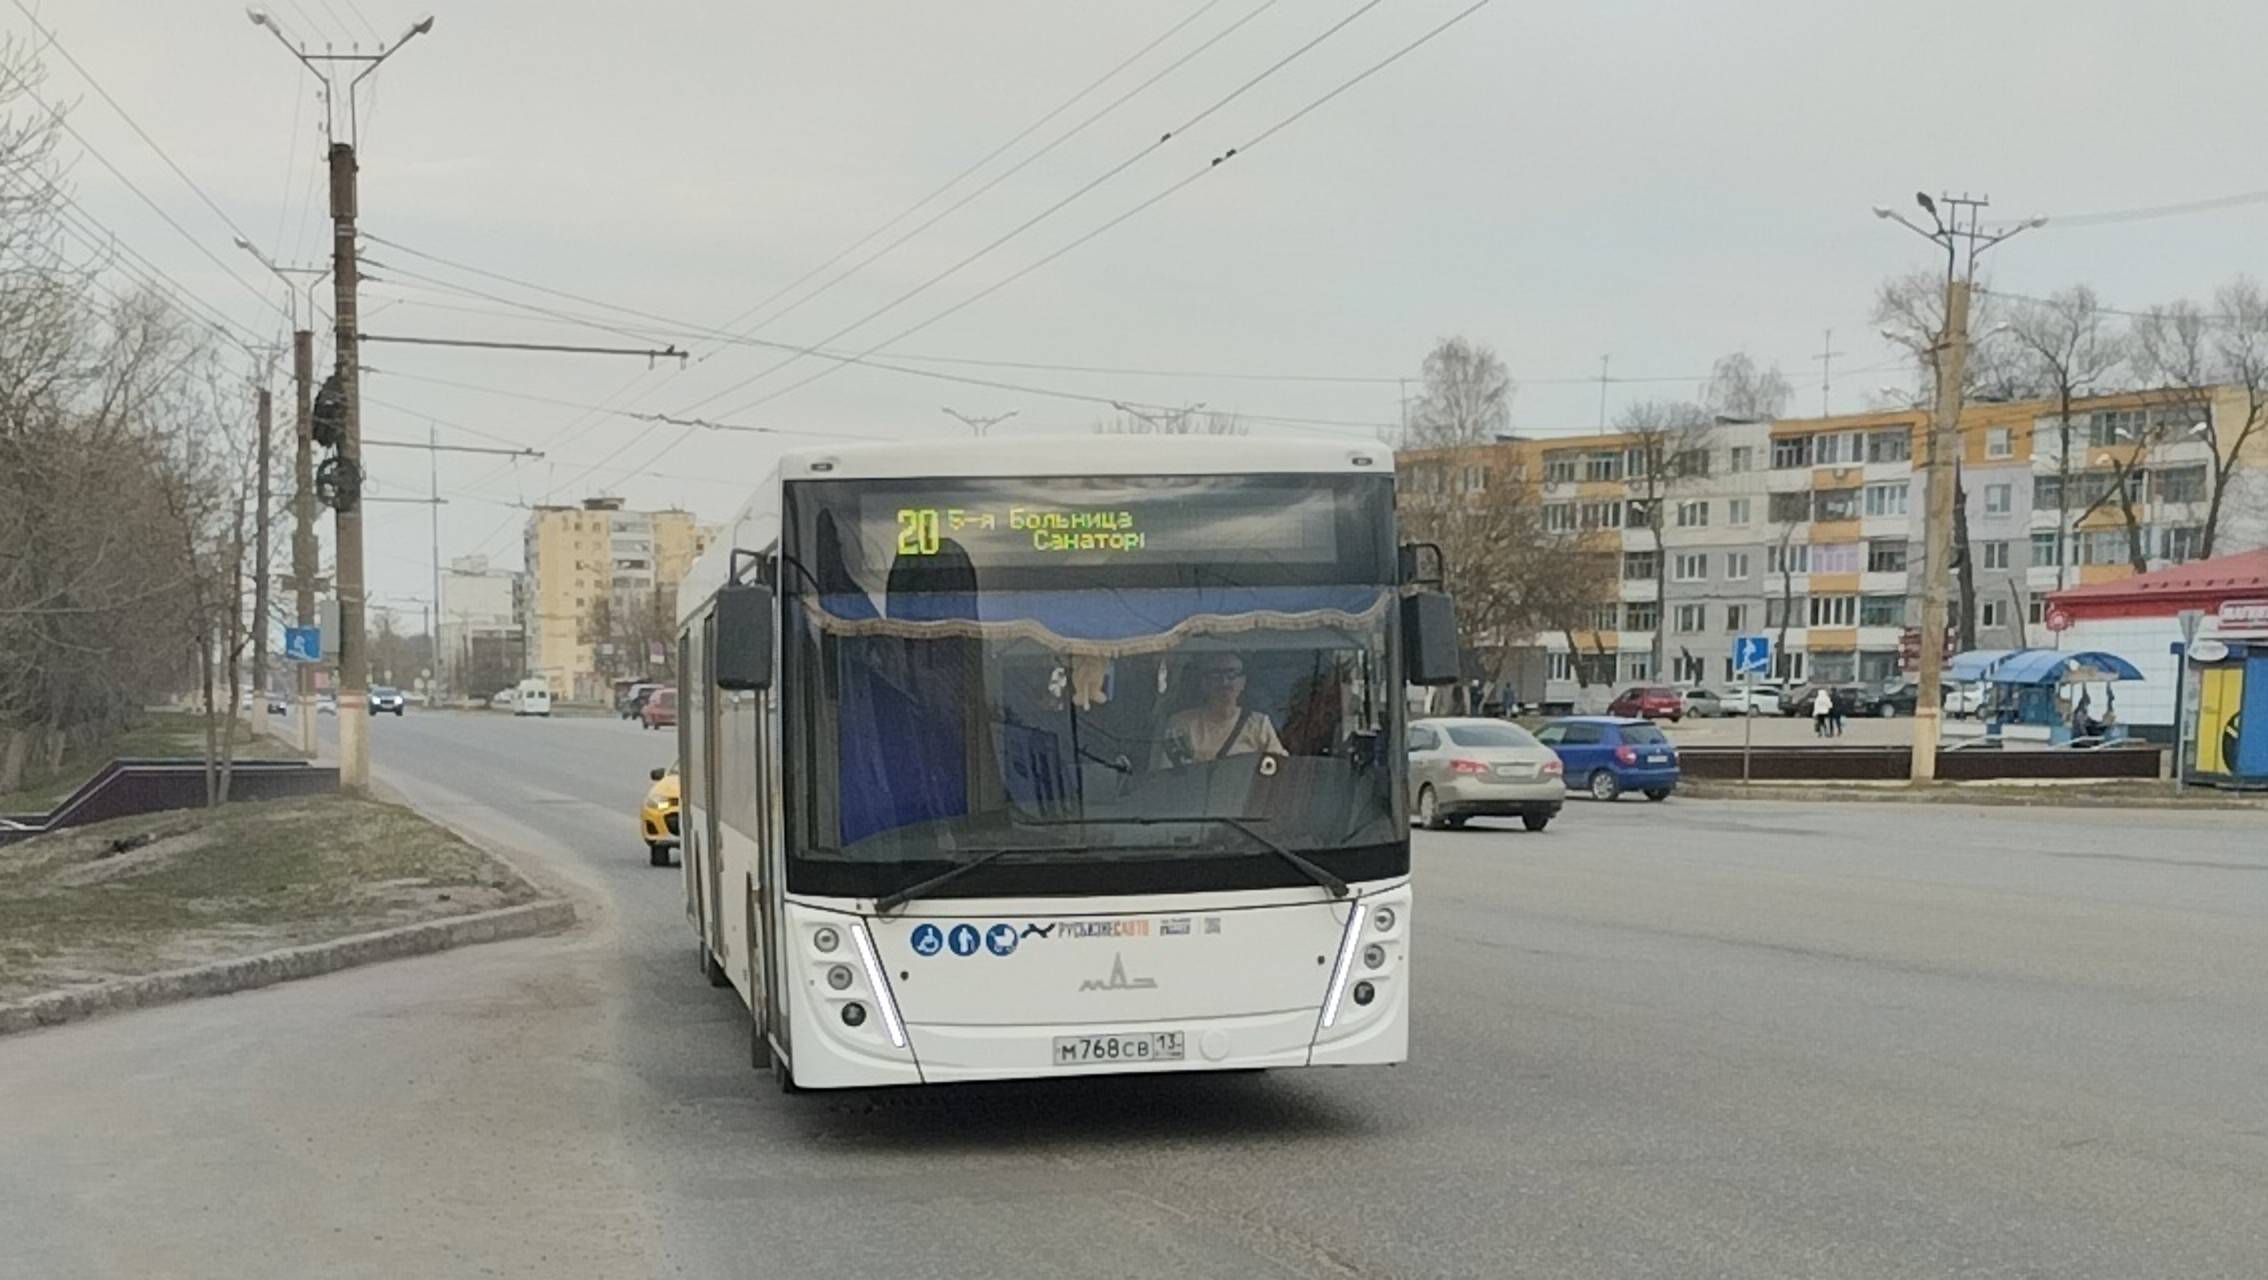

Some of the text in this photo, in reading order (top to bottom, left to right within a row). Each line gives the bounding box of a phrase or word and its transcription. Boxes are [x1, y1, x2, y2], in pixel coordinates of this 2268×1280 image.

[947, 508, 1133, 530] 5-я Больница
[898, 509, 939, 555] 20
[1156, 1033, 1176, 1049] 13
